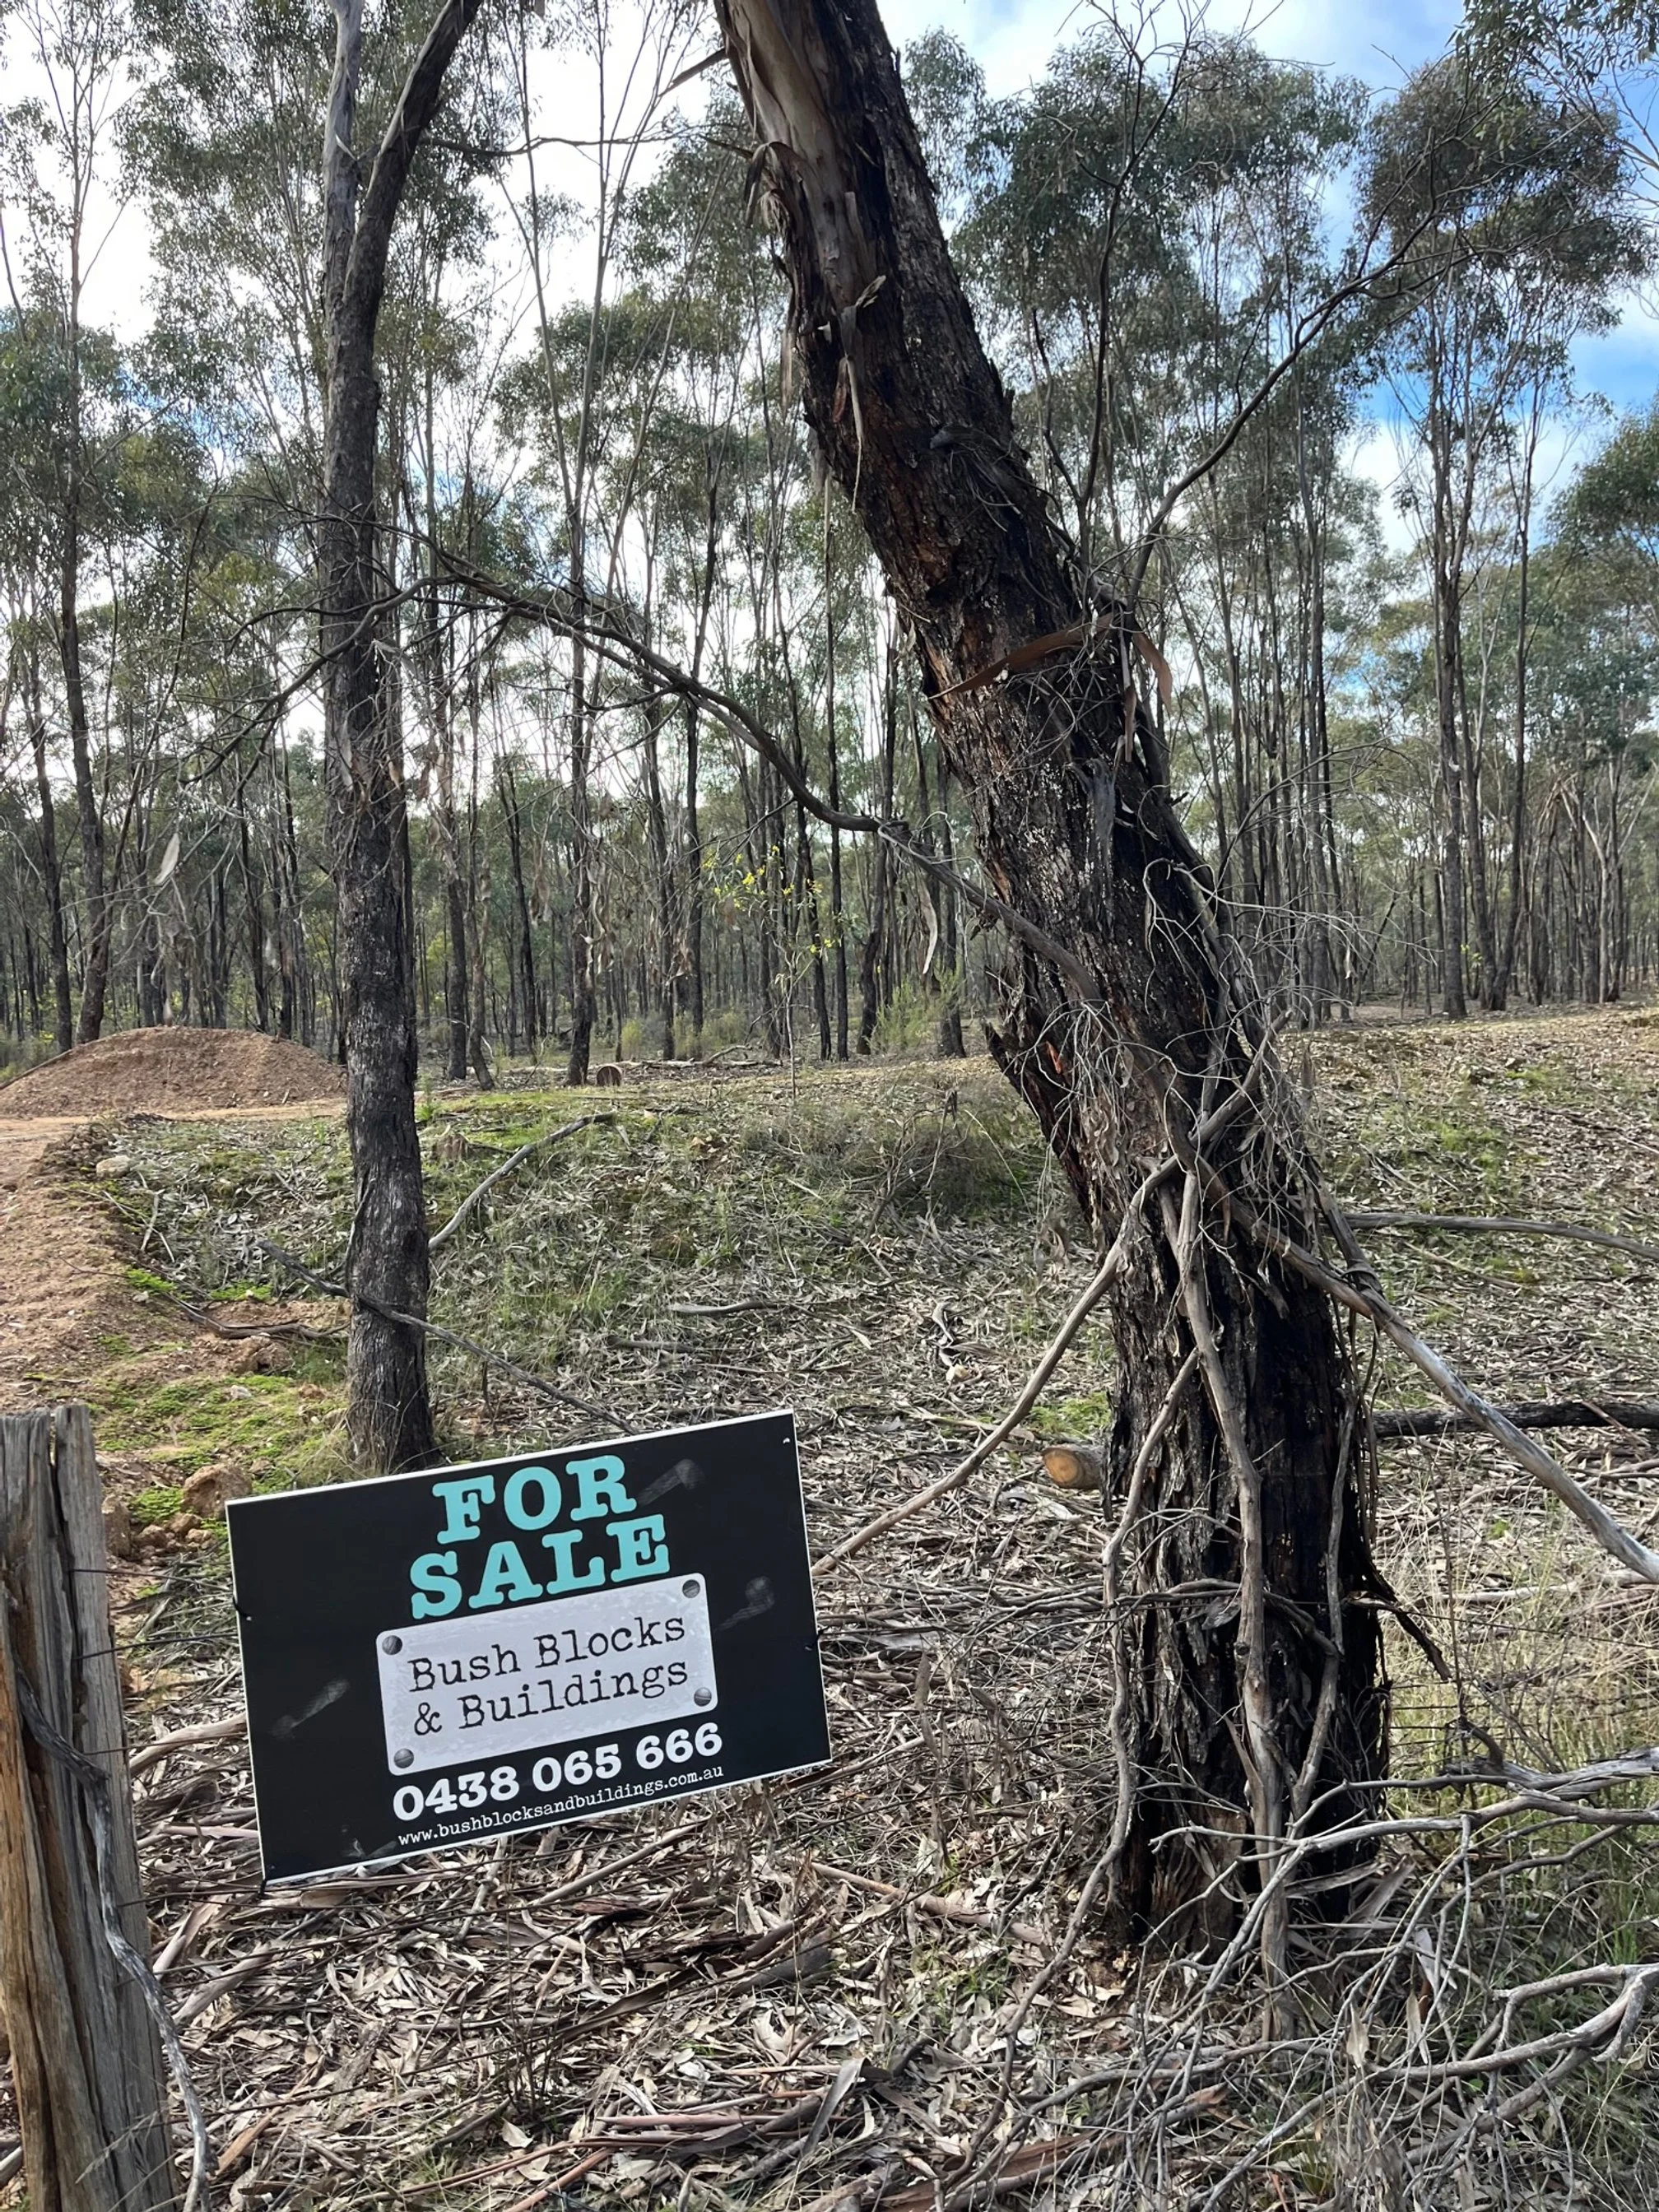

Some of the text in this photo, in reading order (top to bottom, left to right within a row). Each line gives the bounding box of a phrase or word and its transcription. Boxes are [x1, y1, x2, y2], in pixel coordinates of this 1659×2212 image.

[432, 1454, 637, 1545] FOR
[409, 1513, 671, 1620] SALE
[408, 1614, 685, 1694] Bush Blocks
[412, 1657, 688, 1736] & Buildings
[393, 1722, 723, 1821] 0438 065 666
[398, 1764, 723, 1847] www.bushblocksandbuildings.com.au
